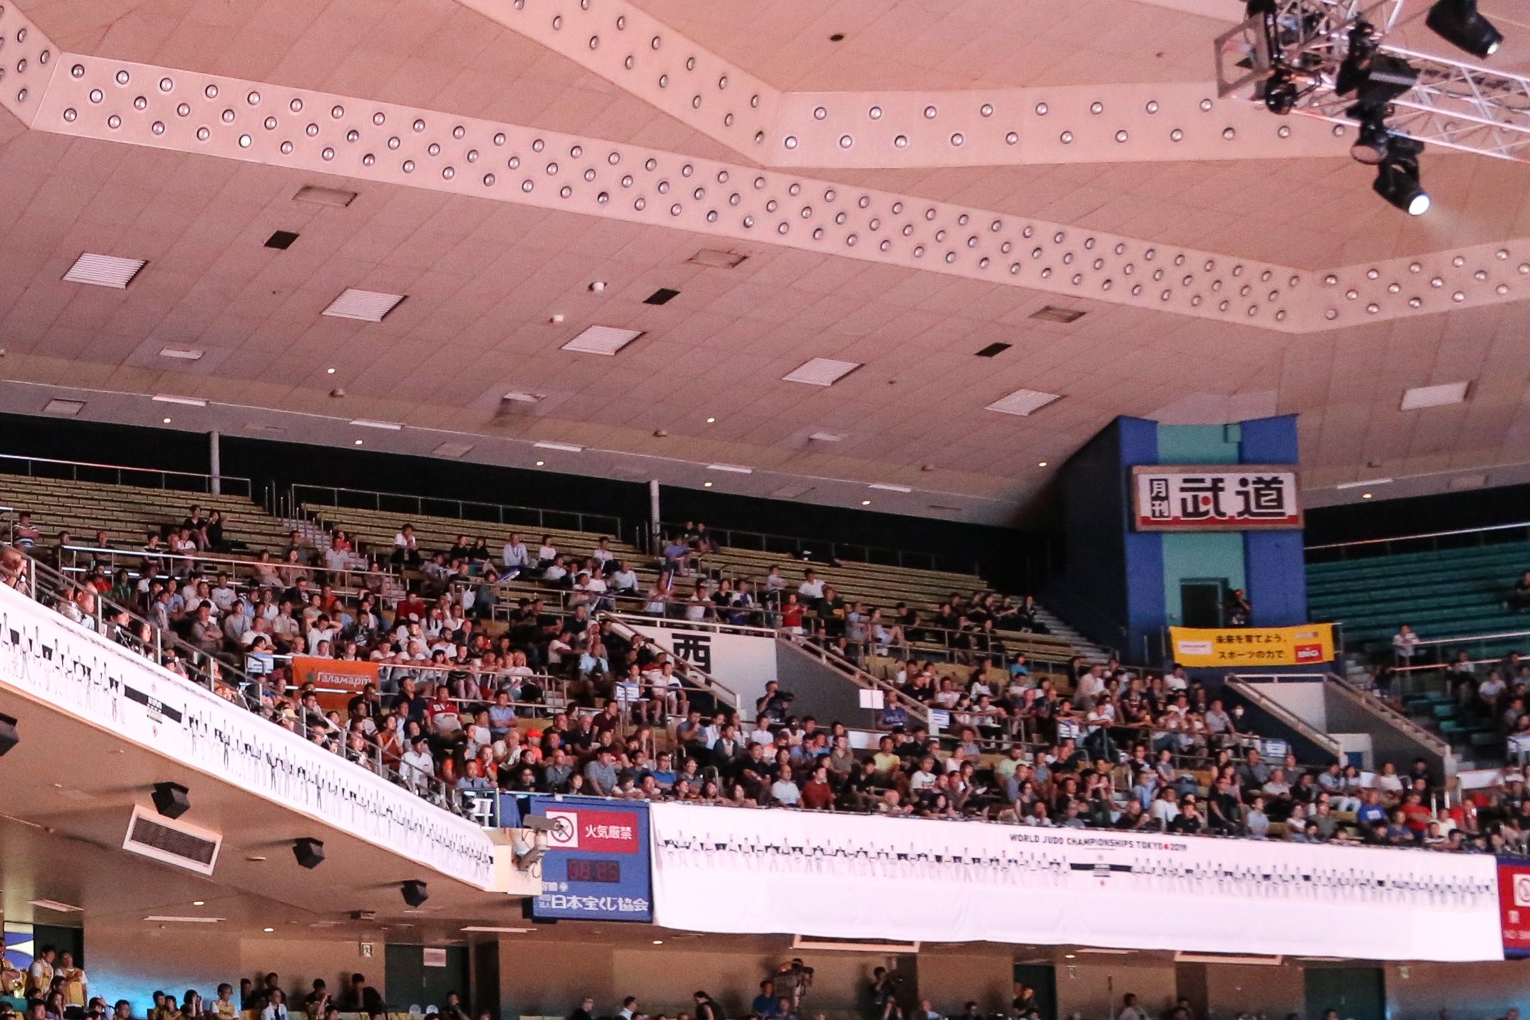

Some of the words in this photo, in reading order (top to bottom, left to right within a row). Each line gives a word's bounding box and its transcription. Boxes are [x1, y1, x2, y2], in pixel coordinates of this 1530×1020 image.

[1150, 478, 1171, 519] 月刊
[1179, 476, 1287, 519] 武道
[671, 632, 712, 688] 西
[584, 824, 633, 840] 火気厳禁
[1009, 833, 1040, 844] WORLD
[1042, 836, 1064, 845] JUDO
[1067, 837, 1134, 849] CHAMPIONSHIPS
[1136, 841, 1163, 851] TOKYO
[551, 894, 650, 912] 日本宝くじ協会
